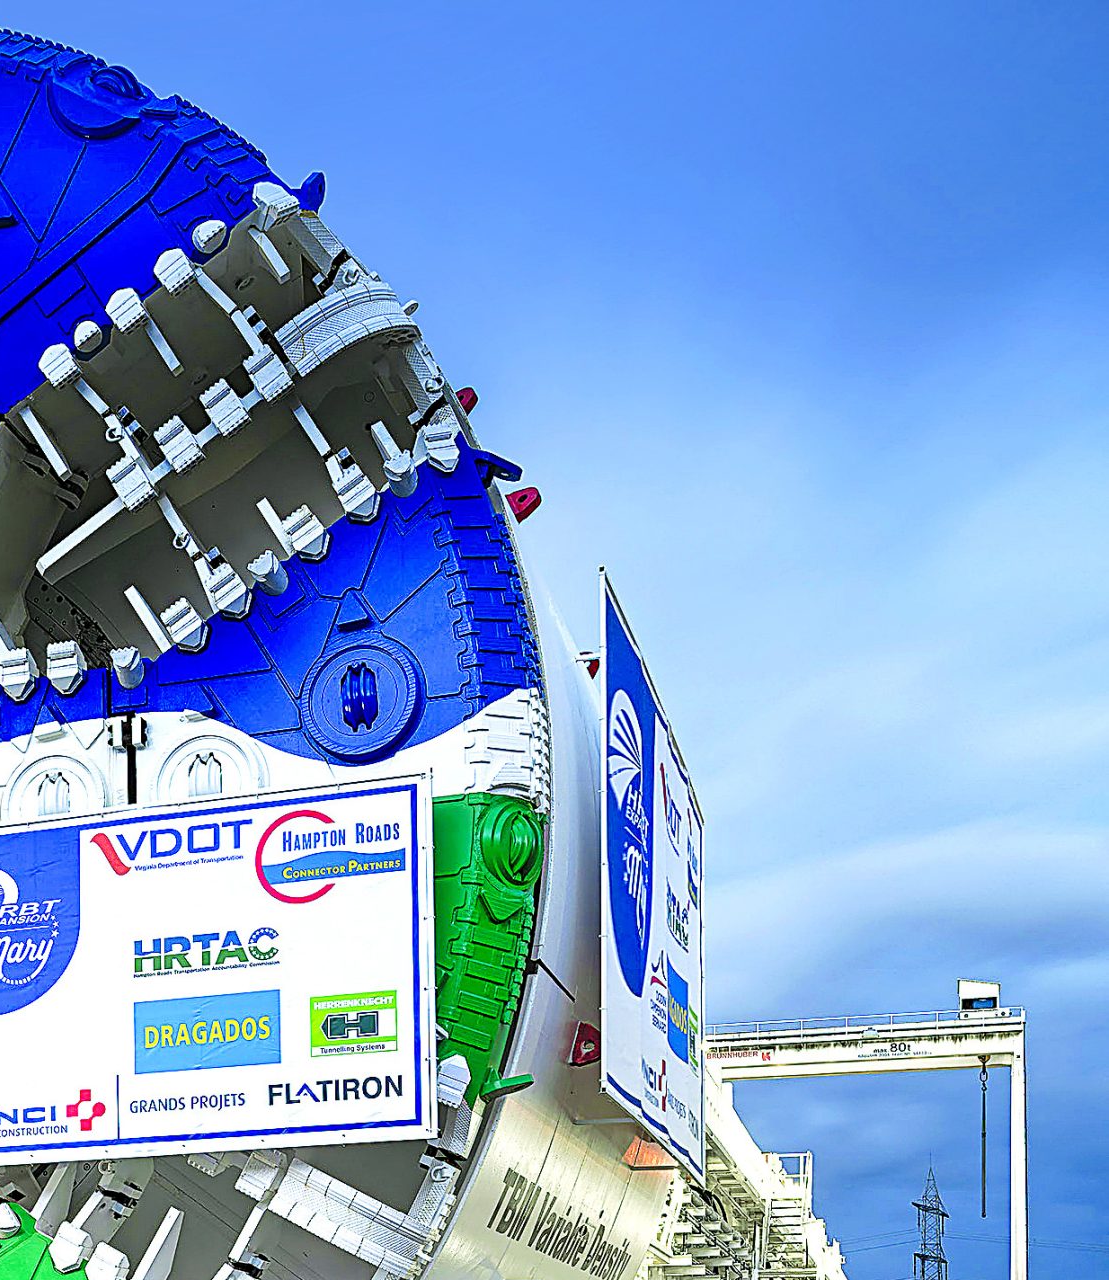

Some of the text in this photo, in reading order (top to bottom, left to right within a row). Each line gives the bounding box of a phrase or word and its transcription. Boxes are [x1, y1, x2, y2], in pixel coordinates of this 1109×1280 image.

[116, 819, 253, 861] VDOT
[282, 822, 400, 852] HAMPTON ROADS
[134, 863, 157, 872] Virginia
[157, 859, 193, 870] Department
[200, 854, 244, 864] Transportation
[282, 859, 401, 879] CONNECTOR PARTNERS
[134, 927, 279, 973] HRTAC
[313, 995, 394, 1011] HERRENKNECHT
[144, 1015, 271, 1050] DRAGADOS
[356, 1043, 386, 1053] Systems
[706, 1050, 759, 1060] BRUNNHUBER
[129, 1092, 246, 1114] GRANDS PROJETS
[268, 1075, 404, 1106] FLATIRON
[486, 1167, 542, 1242] TBM
[527, 1191, 591, 1267] Variable
